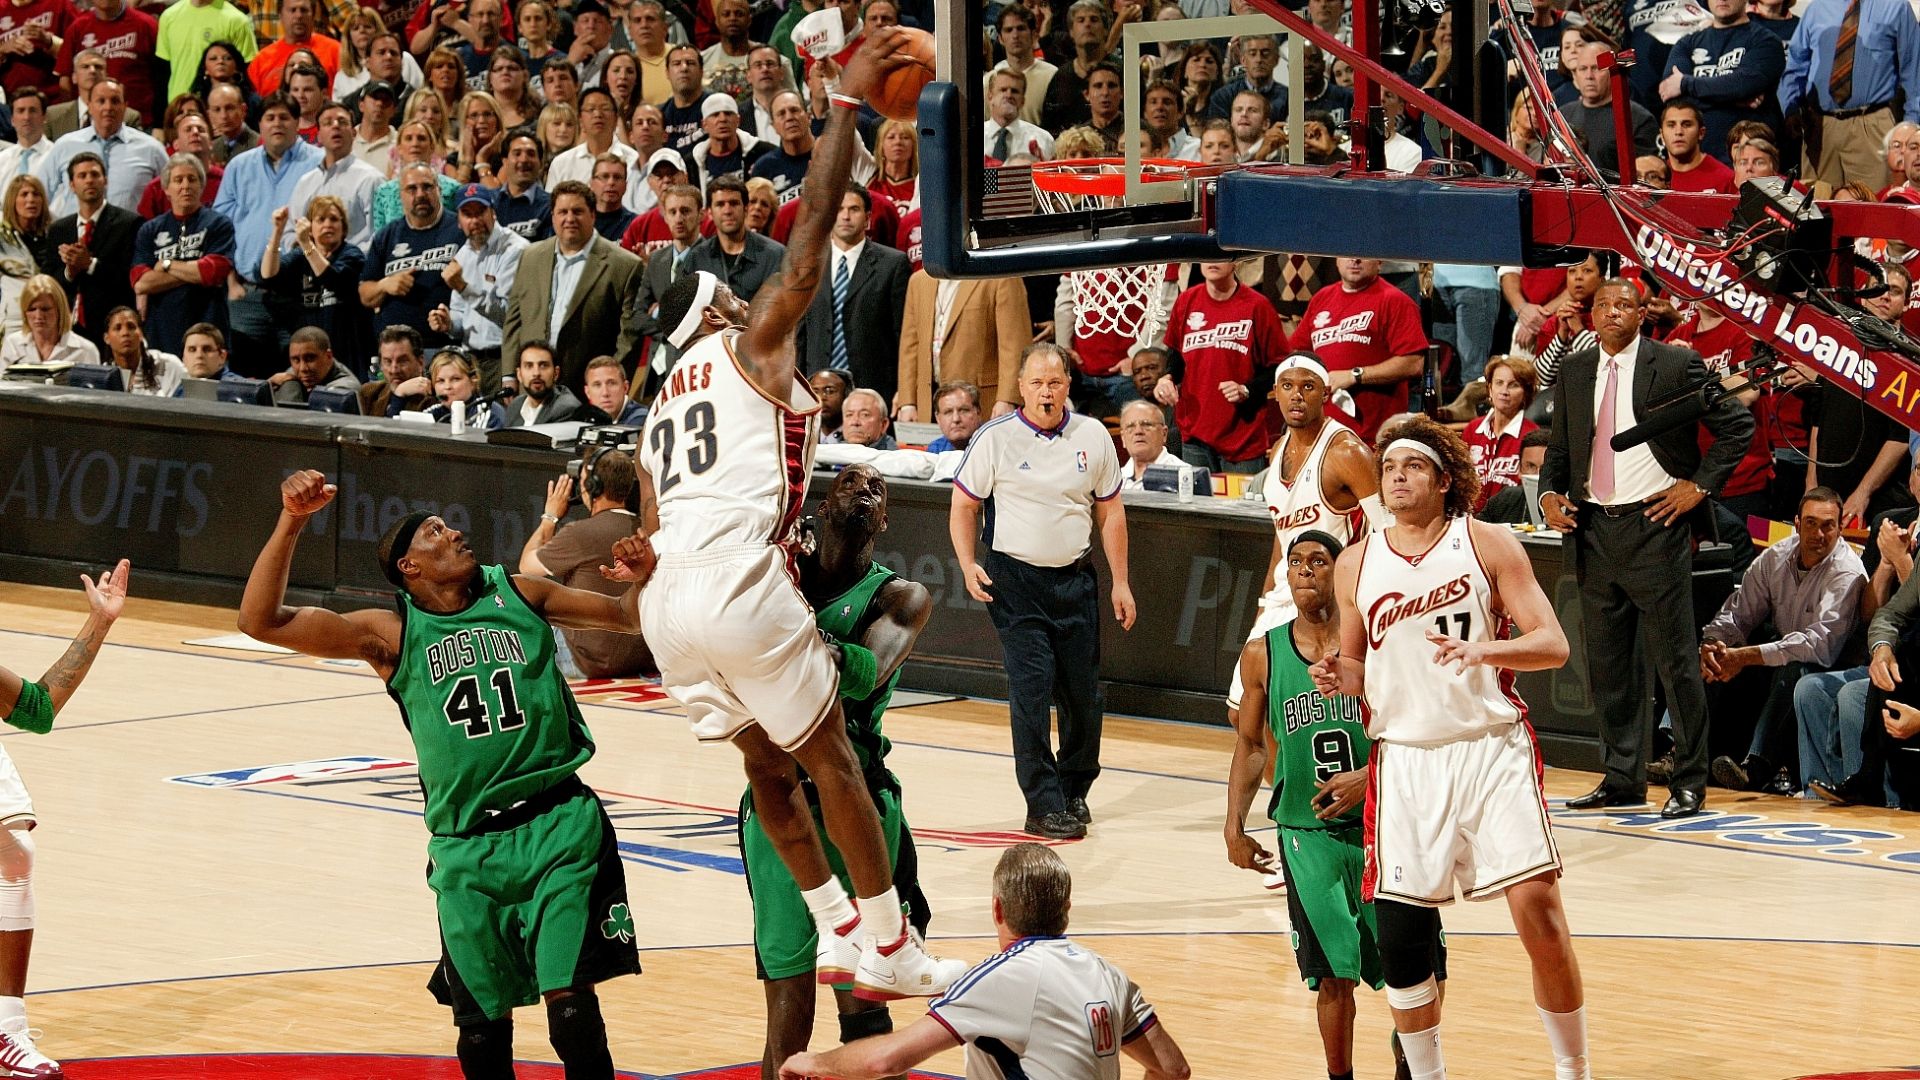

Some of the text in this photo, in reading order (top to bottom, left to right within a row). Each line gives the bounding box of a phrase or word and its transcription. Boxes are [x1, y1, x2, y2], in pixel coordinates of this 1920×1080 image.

[1215, 319, 1253, 341] UP!
[1339, 311, 1374, 333] UP!
[1636, 224, 1768, 325] Quicken
[1774, 302, 1879, 390] Loans
[653, 361, 713, 417] JAMES
[649, 400, 719, 498] 23
[1367, 573, 1471, 651] CAVALIERS
[1434, 611, 1471, 642] 17
[426, 628, 528, 686] BOSTON
[443, 667, 527, 740] 41
[1311, 728, 1355, 784] 9
[1091, 1006, 1113, 1052] 26
